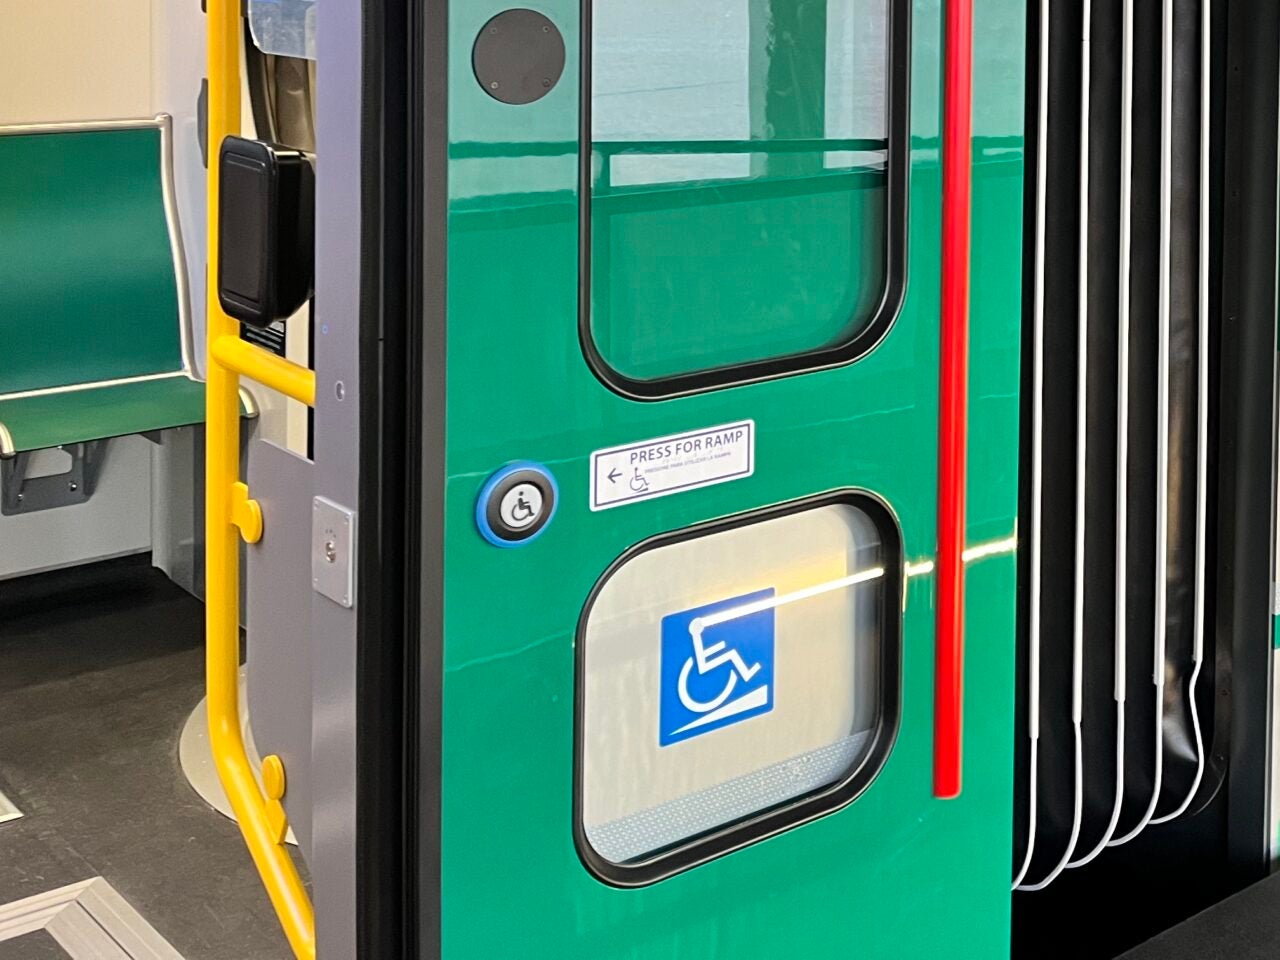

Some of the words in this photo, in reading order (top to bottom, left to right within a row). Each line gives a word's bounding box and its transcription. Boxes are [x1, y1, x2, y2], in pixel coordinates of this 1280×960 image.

[630, 445, 671, 465] PRESS
[675, 438, 702, 455] FOR
[705, 430, 743, 449] RAMP
